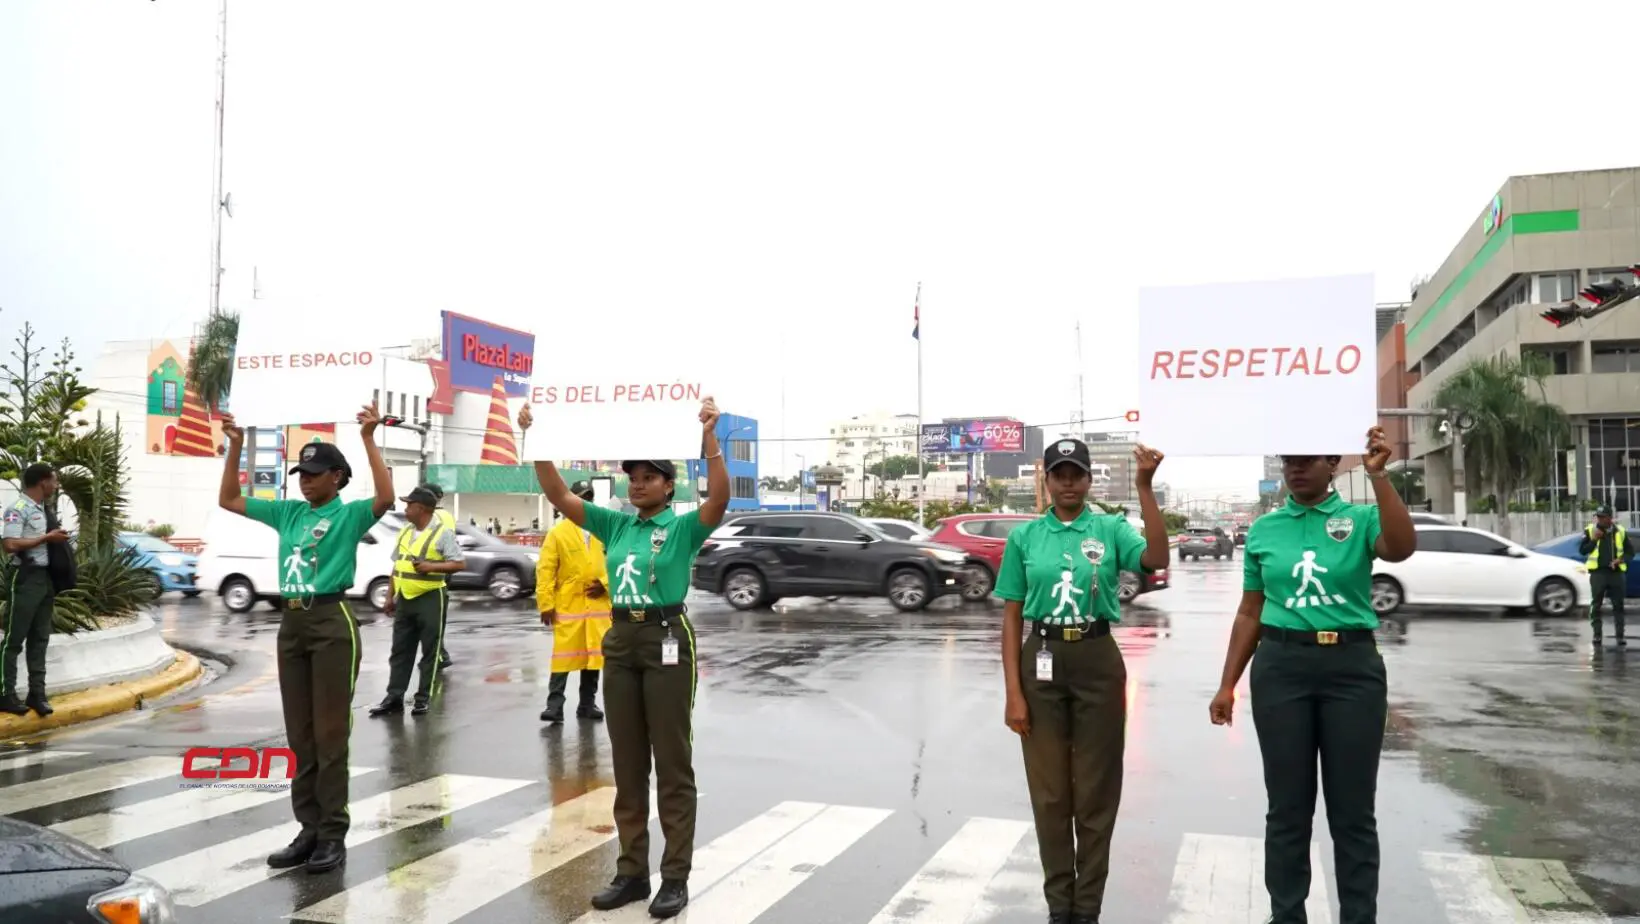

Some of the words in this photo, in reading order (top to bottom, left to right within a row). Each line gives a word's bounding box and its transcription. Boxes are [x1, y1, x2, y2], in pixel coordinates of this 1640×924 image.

[237, 354, 284, 370] ESTE
[289, 351, 373, 368] ESPACIO
[1150, 344, 1362, 380] RESPETALO
[531, 386, 558, 404] ES
[565, 385, 606, 403] DEL
[613, 378, 701, 402] PEATÓN
[983, 424, 1020, 440] 60%
